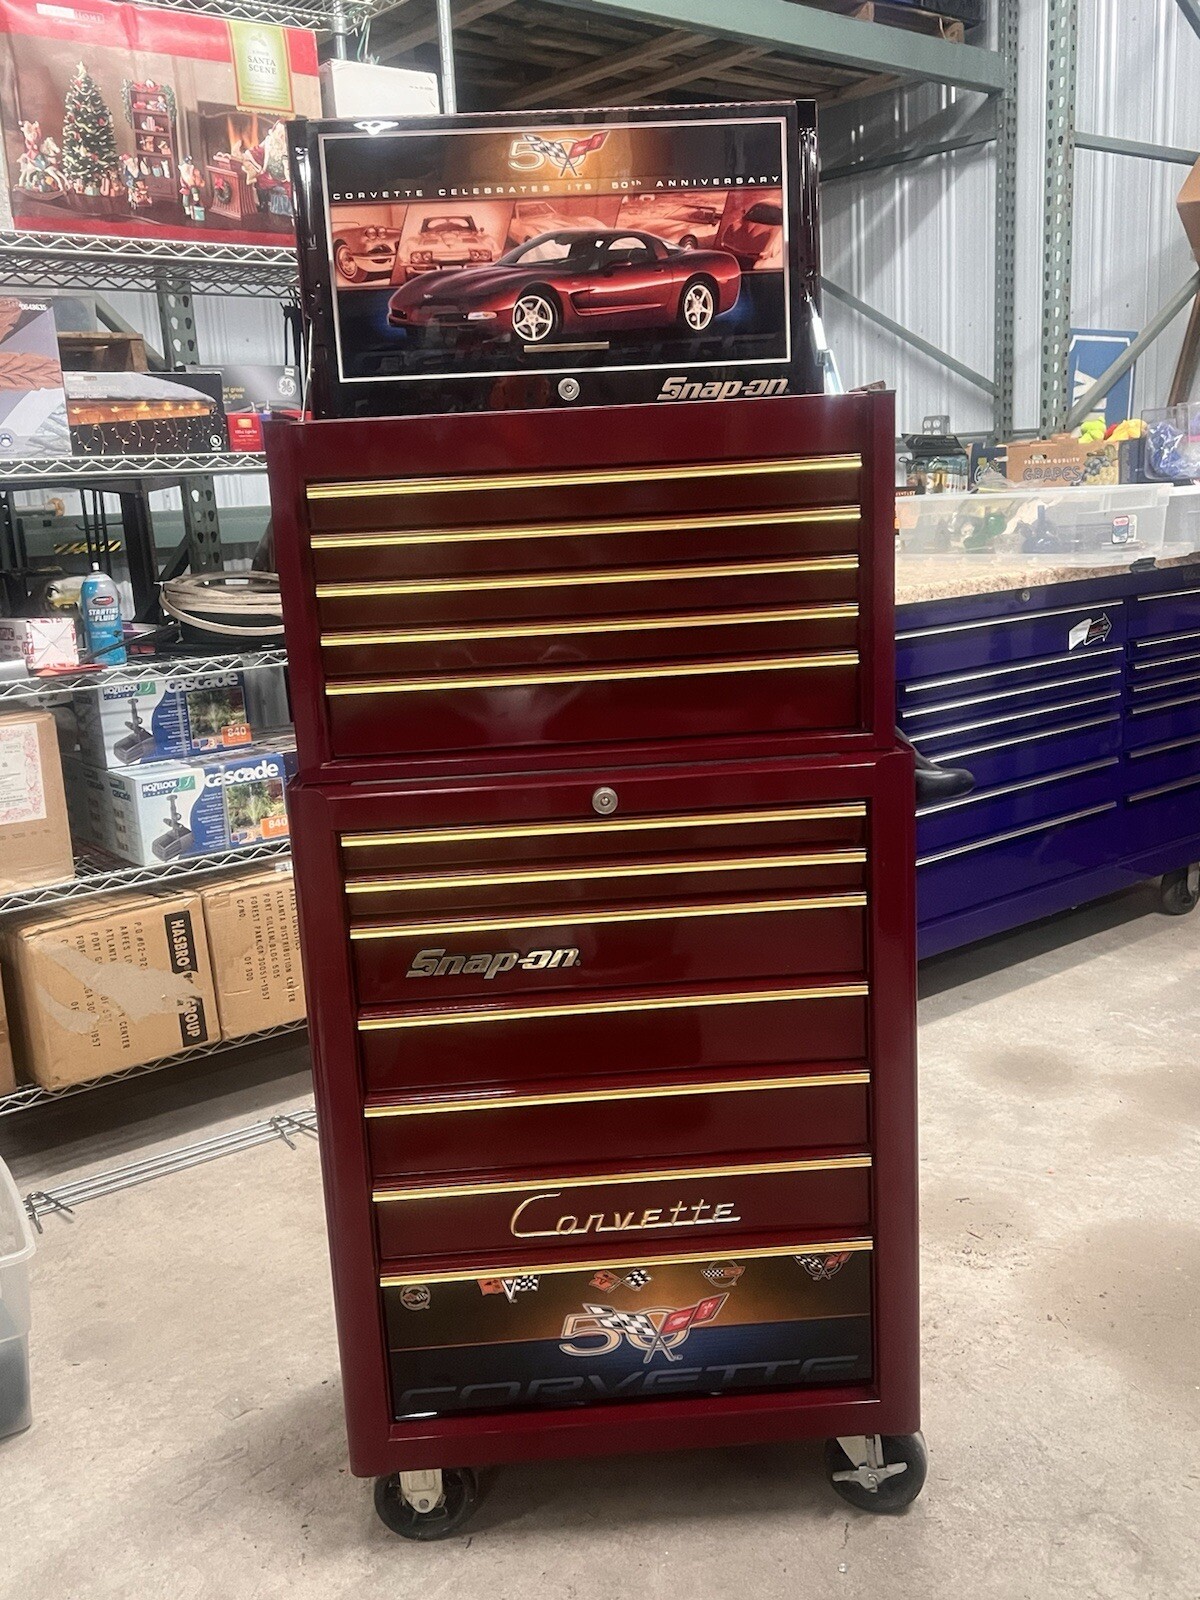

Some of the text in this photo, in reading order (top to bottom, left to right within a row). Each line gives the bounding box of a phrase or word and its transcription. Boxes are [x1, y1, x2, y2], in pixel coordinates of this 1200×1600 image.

[248, 55, 276, 67] SANTA
[249, 64, 277, 75] SCENE
[332, 175, 781, 200] CORVETTE CELEBRATES ITS 50th ANNIVERSARY
[1022, 465, 1082, 482] GRAPES
[165, 672, 239, 693] cascade
[227, 726, 247, 737] 840
[205, 760, 279, 788] cascade
[268, 817, 288, 829] 840
[250, 896, 260, 922] FOREST
[91, 931, 101, 951] PORT
[120, 926, 131, 950] AAFES
[170, 919, 191, 967] HASBRO
[263, 893, 272, 911] PORT
[272, 965, 280, 979] 505
[276, 890, 296, 1003] ATLANTA DISTRIBUTION CENTER
[244, 957, 252, 965] OF
[245, 969, 253, 981] 300
[106, 929, 117, 962] ATLANTA
[119, 1021, 130, 1049] CENTER
